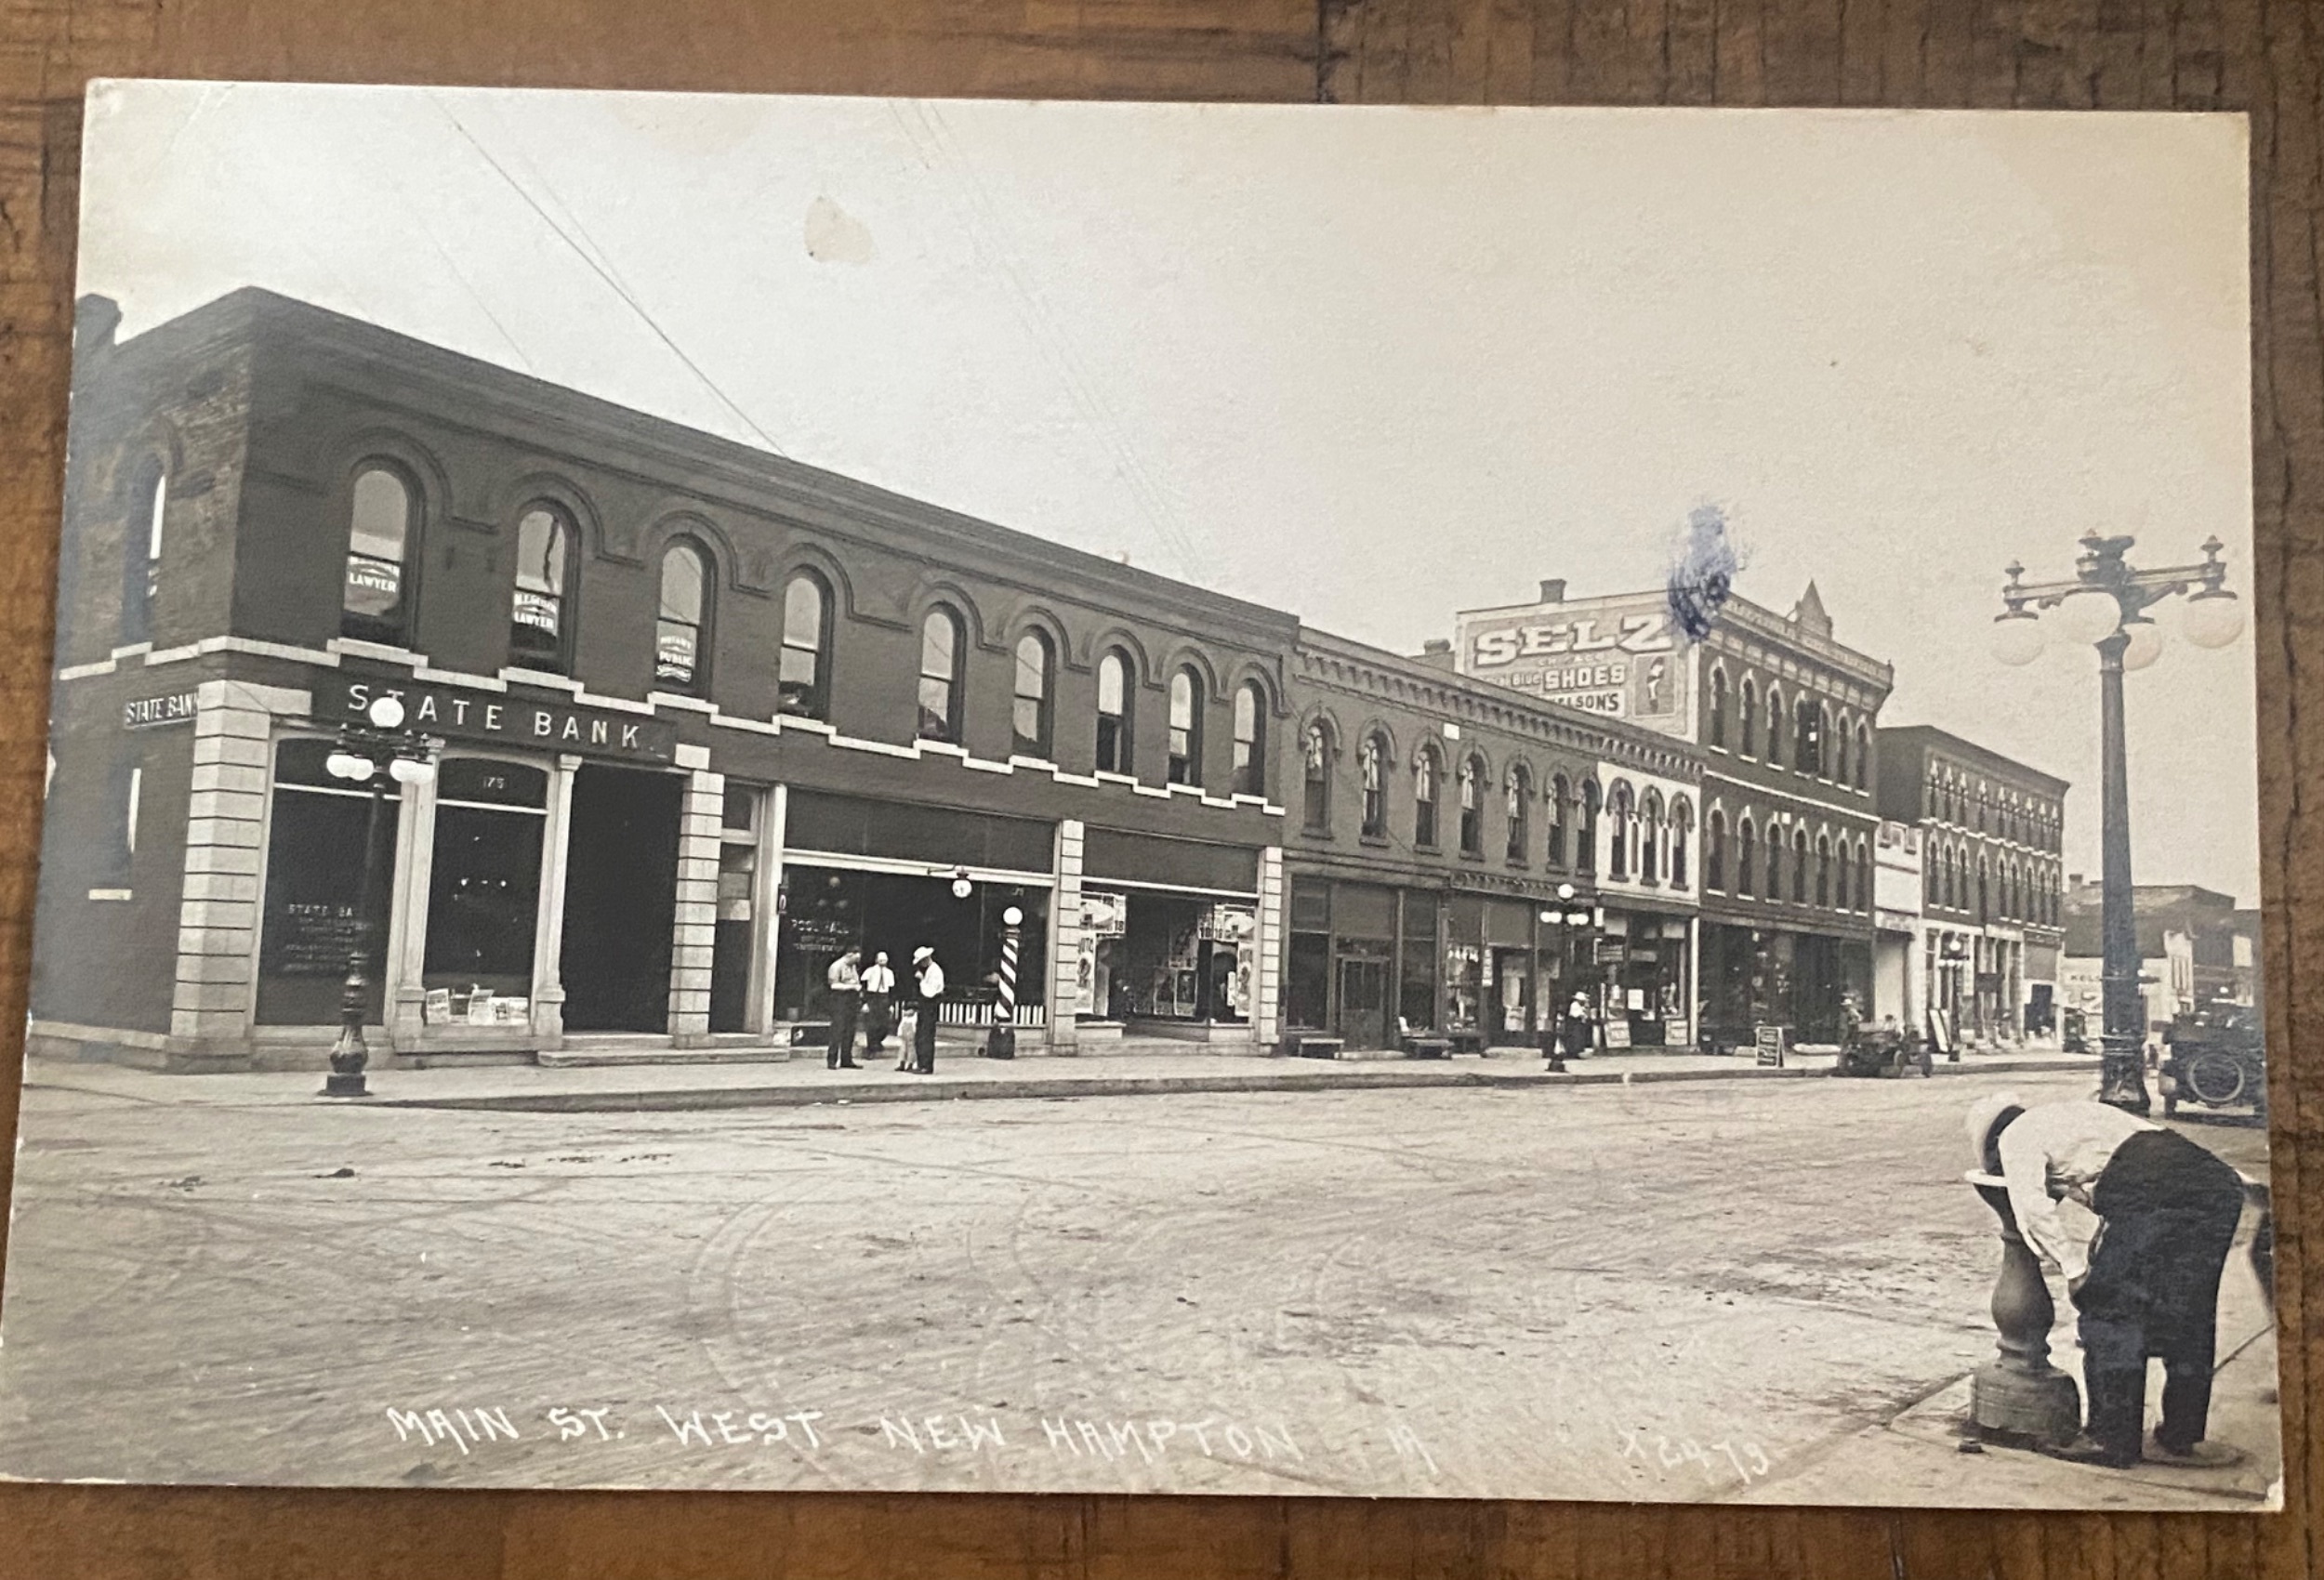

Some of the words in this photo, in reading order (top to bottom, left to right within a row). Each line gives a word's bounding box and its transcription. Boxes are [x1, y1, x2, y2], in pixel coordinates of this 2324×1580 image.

[350, 572, 396, 593] LAWYER
[514, 611, 554, 629] LAWYER
[1474, 612, 1673, 665] SELZ
[659, 651, 693, 666] PUBLIC
[1544, 663, 1625, 691] SHOES
[126, 697, 165, 723] STATE
[534, 710, 640, 749] BANK
[386, 1406, 520, 1455] MAIN
[548, 1407, 625, 1442] ST.
[654, 1403, 824, 1450] WEST
[880, 1406, 1008, 1454] NEW
[1040, 1416, 1304, 1465] HAMPTON
